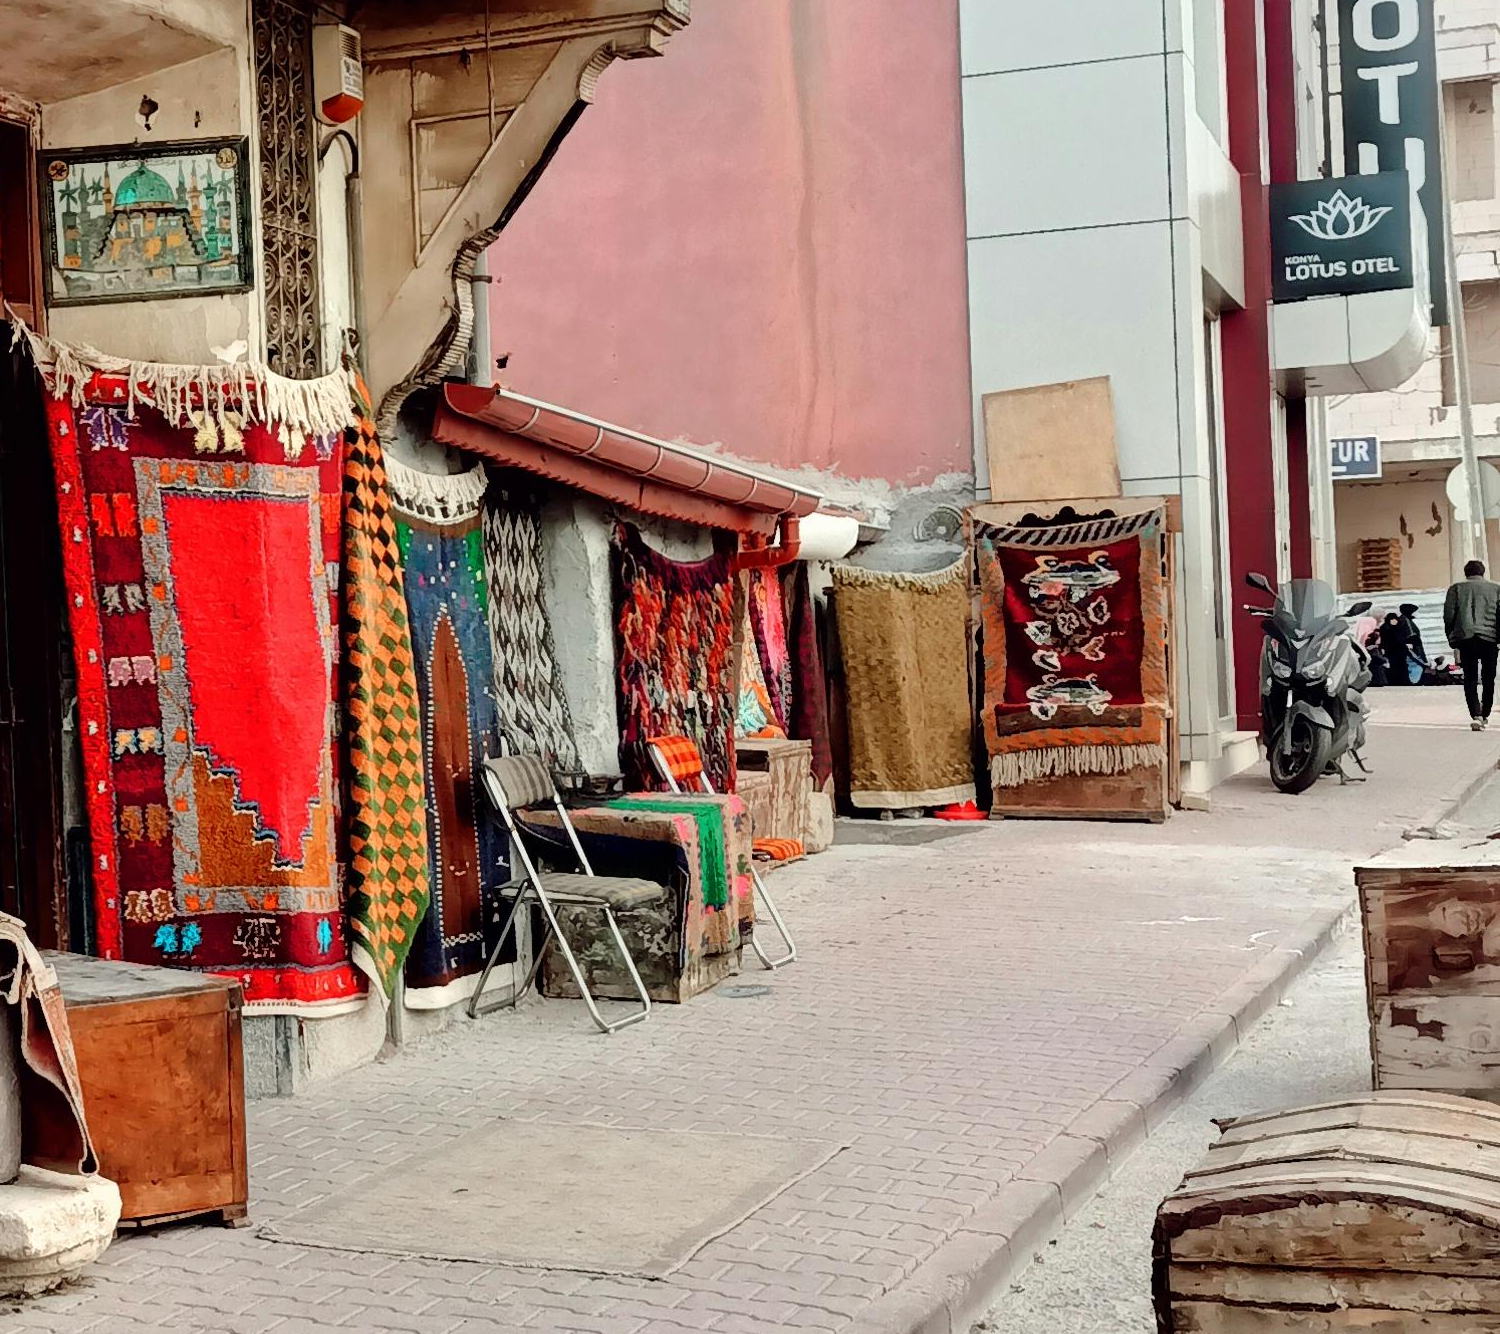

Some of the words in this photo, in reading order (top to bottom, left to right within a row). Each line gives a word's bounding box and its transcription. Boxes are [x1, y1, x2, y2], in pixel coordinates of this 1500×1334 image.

[1285, 254, 1321, 266] KONYA
[1285, 261, 1347, 282] LOTUS
[1351, 257, 1401, 276] OTEL
